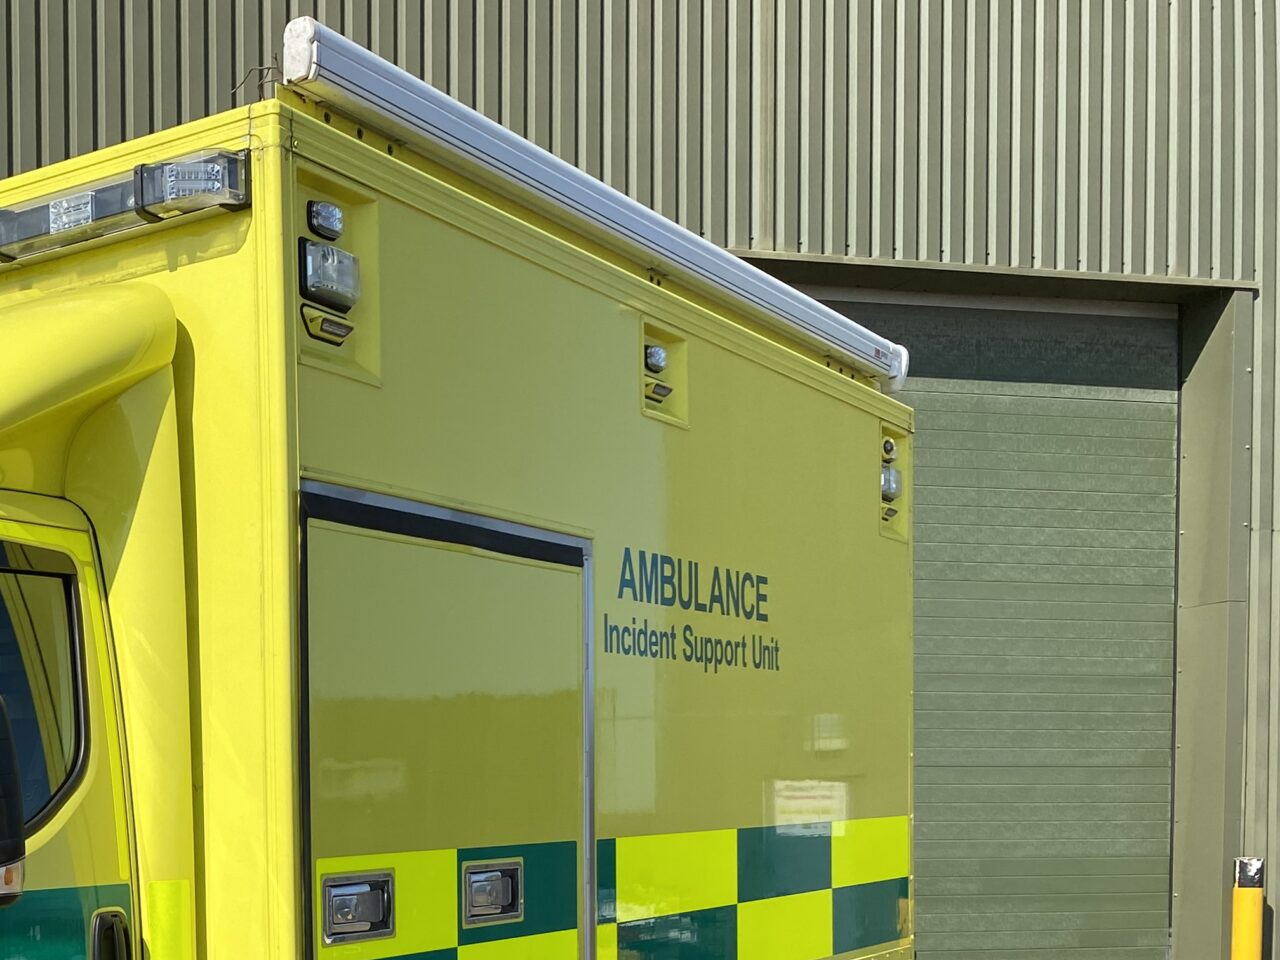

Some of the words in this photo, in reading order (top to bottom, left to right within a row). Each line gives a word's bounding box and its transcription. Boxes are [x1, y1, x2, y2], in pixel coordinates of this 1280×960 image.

[617, 547, 768, 622] AMBULANCE
[604, 613, 677, 660] Incident
[682, 624, 747, 674] Support
[752, 634, 780, 671] Unit
